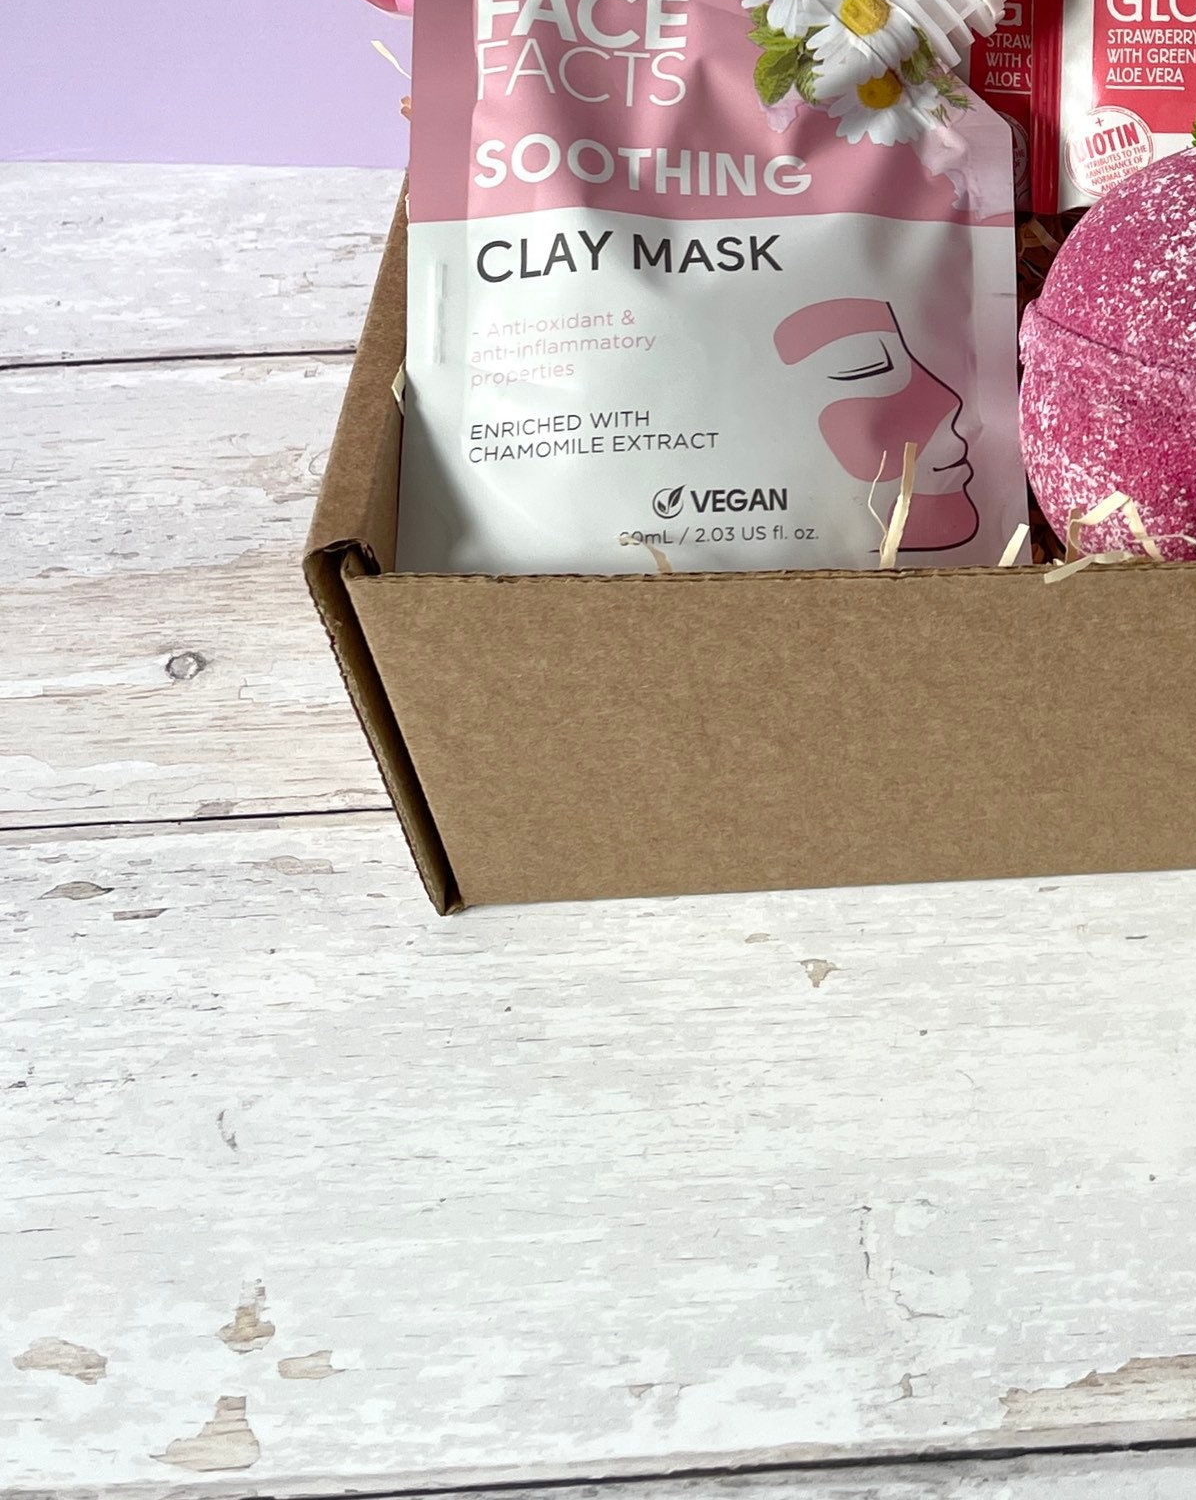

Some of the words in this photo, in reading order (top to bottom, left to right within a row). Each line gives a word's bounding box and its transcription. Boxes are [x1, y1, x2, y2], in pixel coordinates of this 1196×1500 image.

[985, 51, 1022, 69] WITH
[1106, 47, 1144, 65] WITH
[1146, 47, 1196, 65] GREEN
[476, 37, 687, 108] FACTS
[984, 70, 1021, 88] ALOE
[1105, 66, 1143, 84] ALOE
[1145, 67, 1185, 84] VERA
[473, 132, 813, 197] SOOTHING
[476, 230, 614, 284] CLAY
[632, 232, 785, 274] MASK
[487, 310, 614, 339] Anti-oxidant
[620, 309, 636, 327] &
[470, 334, 657, 365] anti-inflammatory
[470, 362, 575, 390] properties
[470, 414, 582, 441] ENRICHED
[589, 409, 651, 430] WITH
[468, 436, 604, 464] CHAMOMILE
[612, 432, 720, 452] EXTRACT
[689, 487, 789, 514] VEGAN
[694, 526, 736, 543] 2.03
[741, 525, 767, 541] US
[772, 525, 789, 541] fl.
[793, 526, 820, 541] oz.
